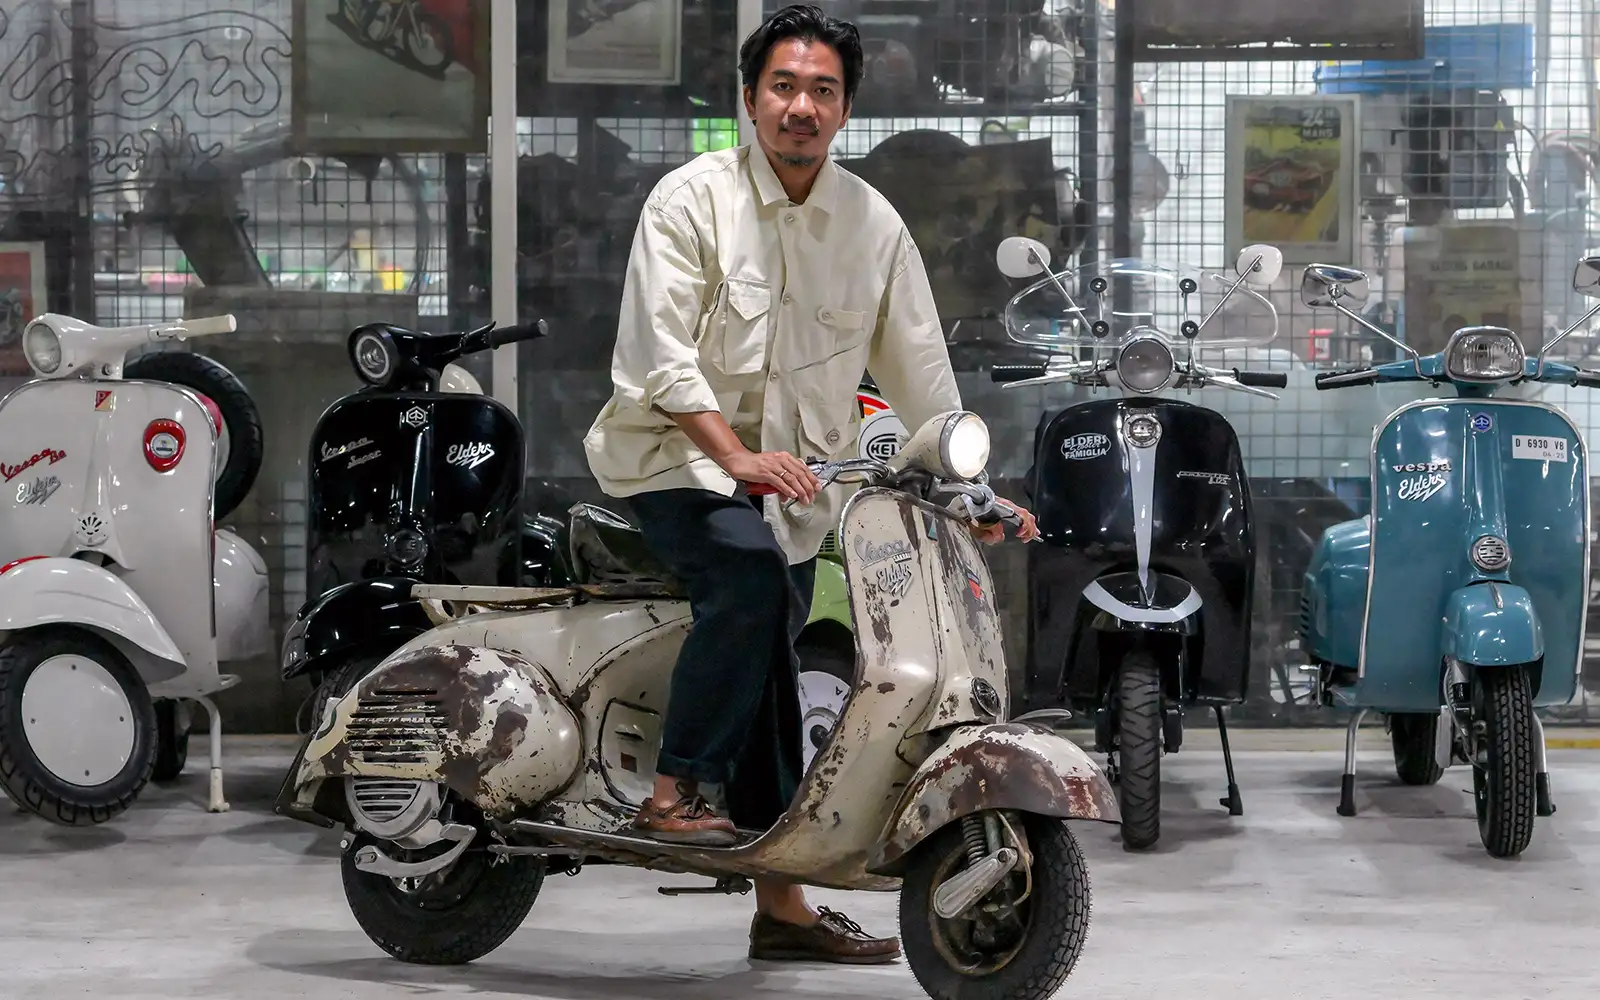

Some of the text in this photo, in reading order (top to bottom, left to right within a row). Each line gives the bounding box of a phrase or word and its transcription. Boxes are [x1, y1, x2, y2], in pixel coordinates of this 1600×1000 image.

[1064, 434, 1107, 449] ELDERS
[1515, 438, 1565, 451] D 6930 VB
[870, 443, 902, 456] HEL
[1065, 448, 1107, 460] FAMIGLIA
[1392, 462, 1452, 473] vespa
